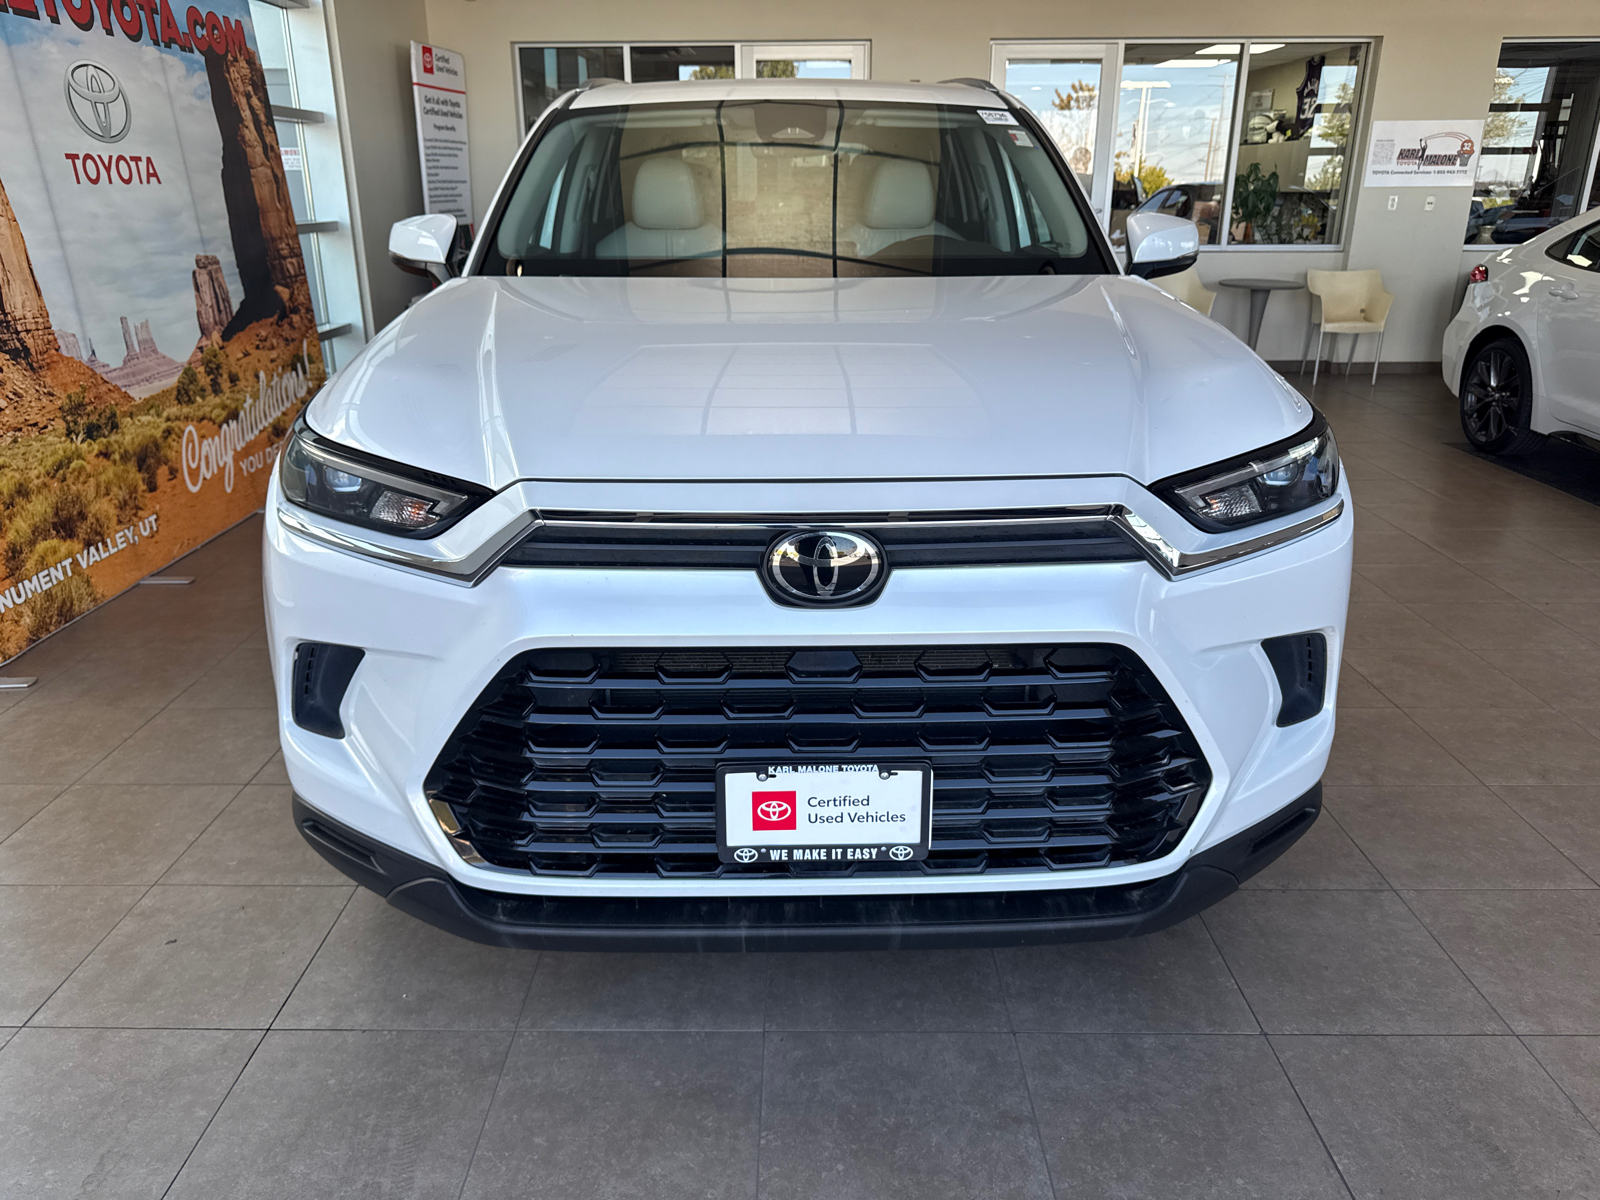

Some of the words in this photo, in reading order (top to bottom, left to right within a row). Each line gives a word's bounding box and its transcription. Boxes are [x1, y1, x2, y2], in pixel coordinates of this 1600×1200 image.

[1300, 97, 1317, 119] 32
[1462, 142, 1472, 151] 32
[1397, 148, 1421, 160] KARL
[1423, 154, 1459, 166] MALONE
[64, 152, 162, 186] TOYOTA
[181, 337, 313, 494] Congratulations!
[239, 454, 264, 478] YOU
[75, 525, 139, 569] VALLEY,
[138, 513, 158, 537] UT
[768, 766, 795, 774] KARL
[798, 765, 839, 773] MALONE
[841, 764, 879, 772] TOYOTA
[807, 795, 870, 808] Certified
[807, 811, 844, 824] Used
[847, 811, 906, 823] Vehicles
[770, 849, 788, 860] WE
[793, 848, 827, 860] MAKE
[831, 848, 843, 859] IT
[847, 848, 878, 859] EASY
